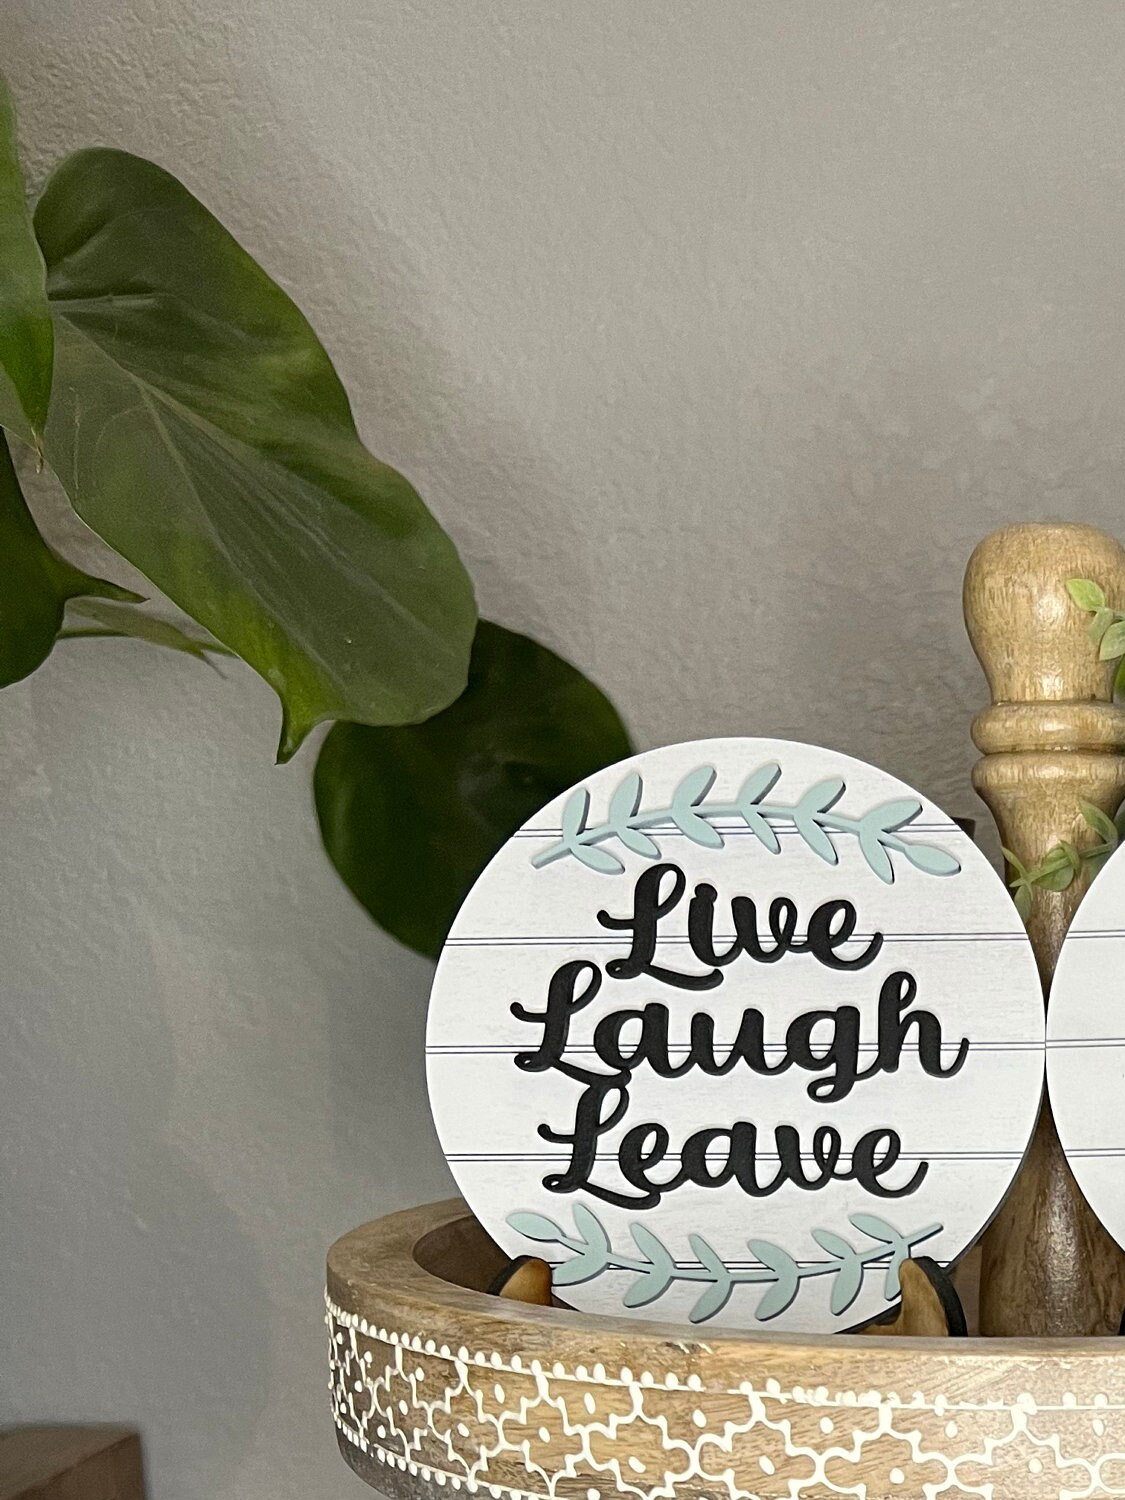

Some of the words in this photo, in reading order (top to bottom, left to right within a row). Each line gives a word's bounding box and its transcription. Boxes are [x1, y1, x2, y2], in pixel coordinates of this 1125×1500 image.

[597, 863, 884, 991] Live
[510, 960, 970, 1103] Laugh
[537, 1082, 929, 1210] Leave
